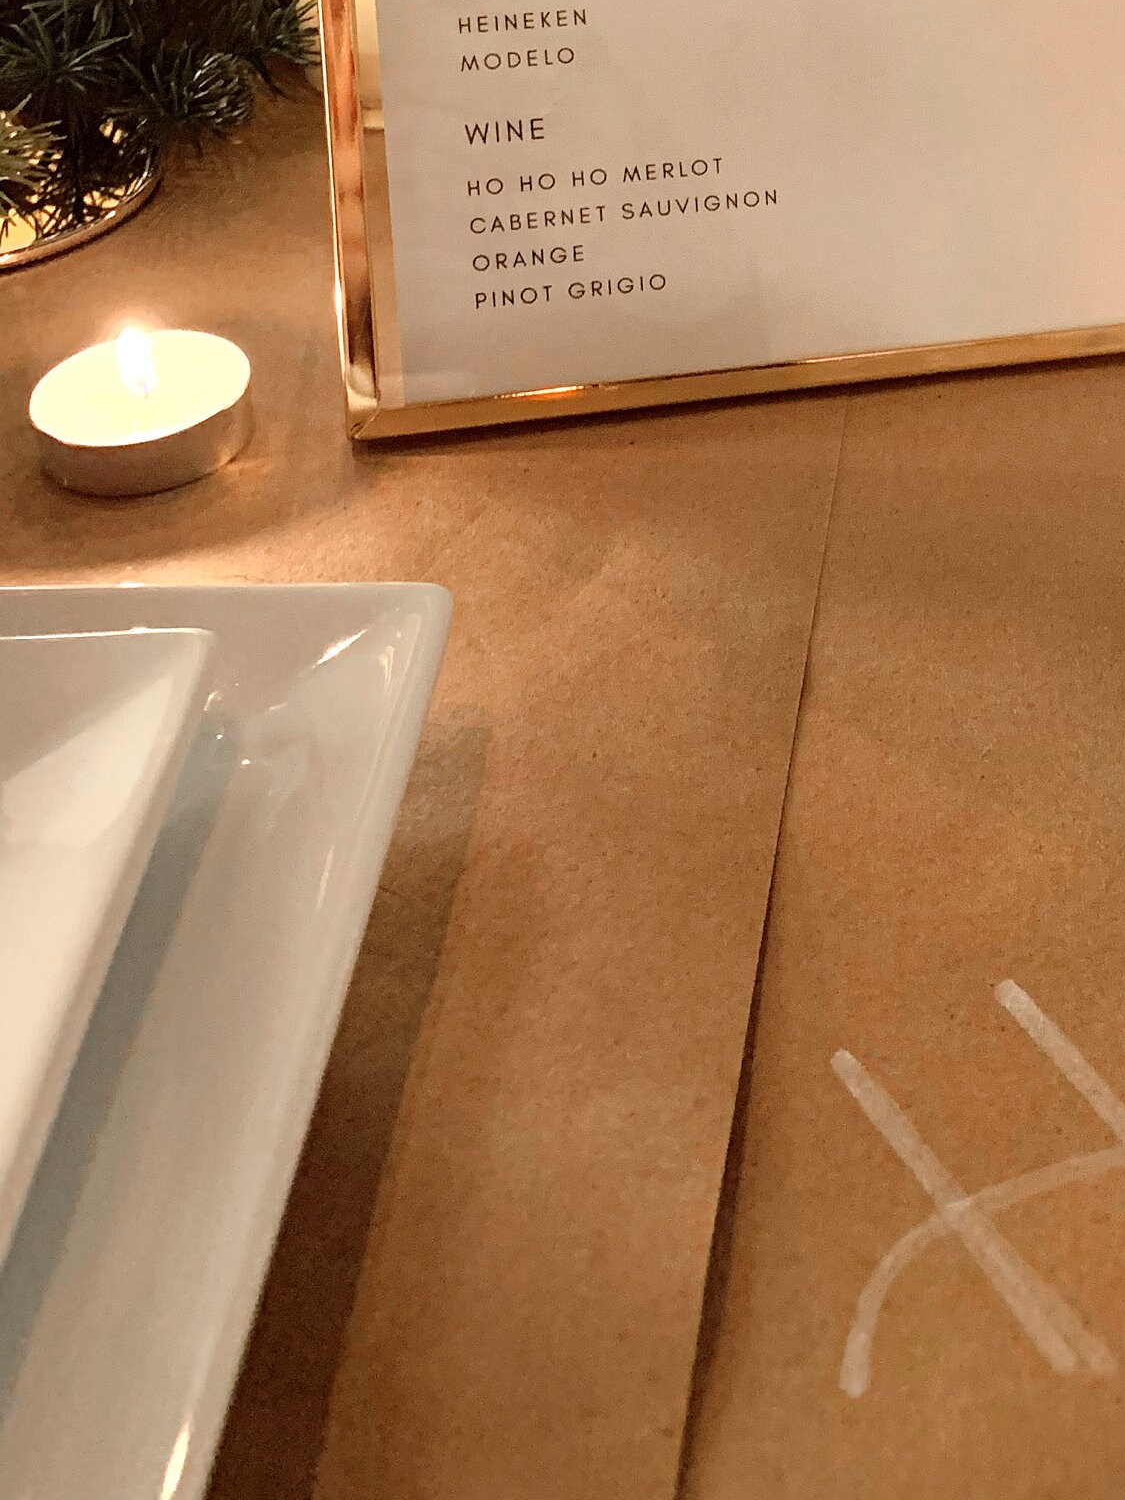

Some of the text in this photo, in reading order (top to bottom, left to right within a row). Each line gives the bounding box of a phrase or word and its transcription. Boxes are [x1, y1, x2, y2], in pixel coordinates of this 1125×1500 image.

[458, 8, 587, 35] HEINEKEN
[460, 46, 575, 73] MODELO
[464, 117, 545, 146] WINE
[466, 156, 723, 197] HO HO HO MERLOT
[469, 188, 778, 235] CABERNET SAUVIGNON
[472, 244, 585, 272] ORANGE
[474, 273, 667, 310] PINOT GRIGIO
